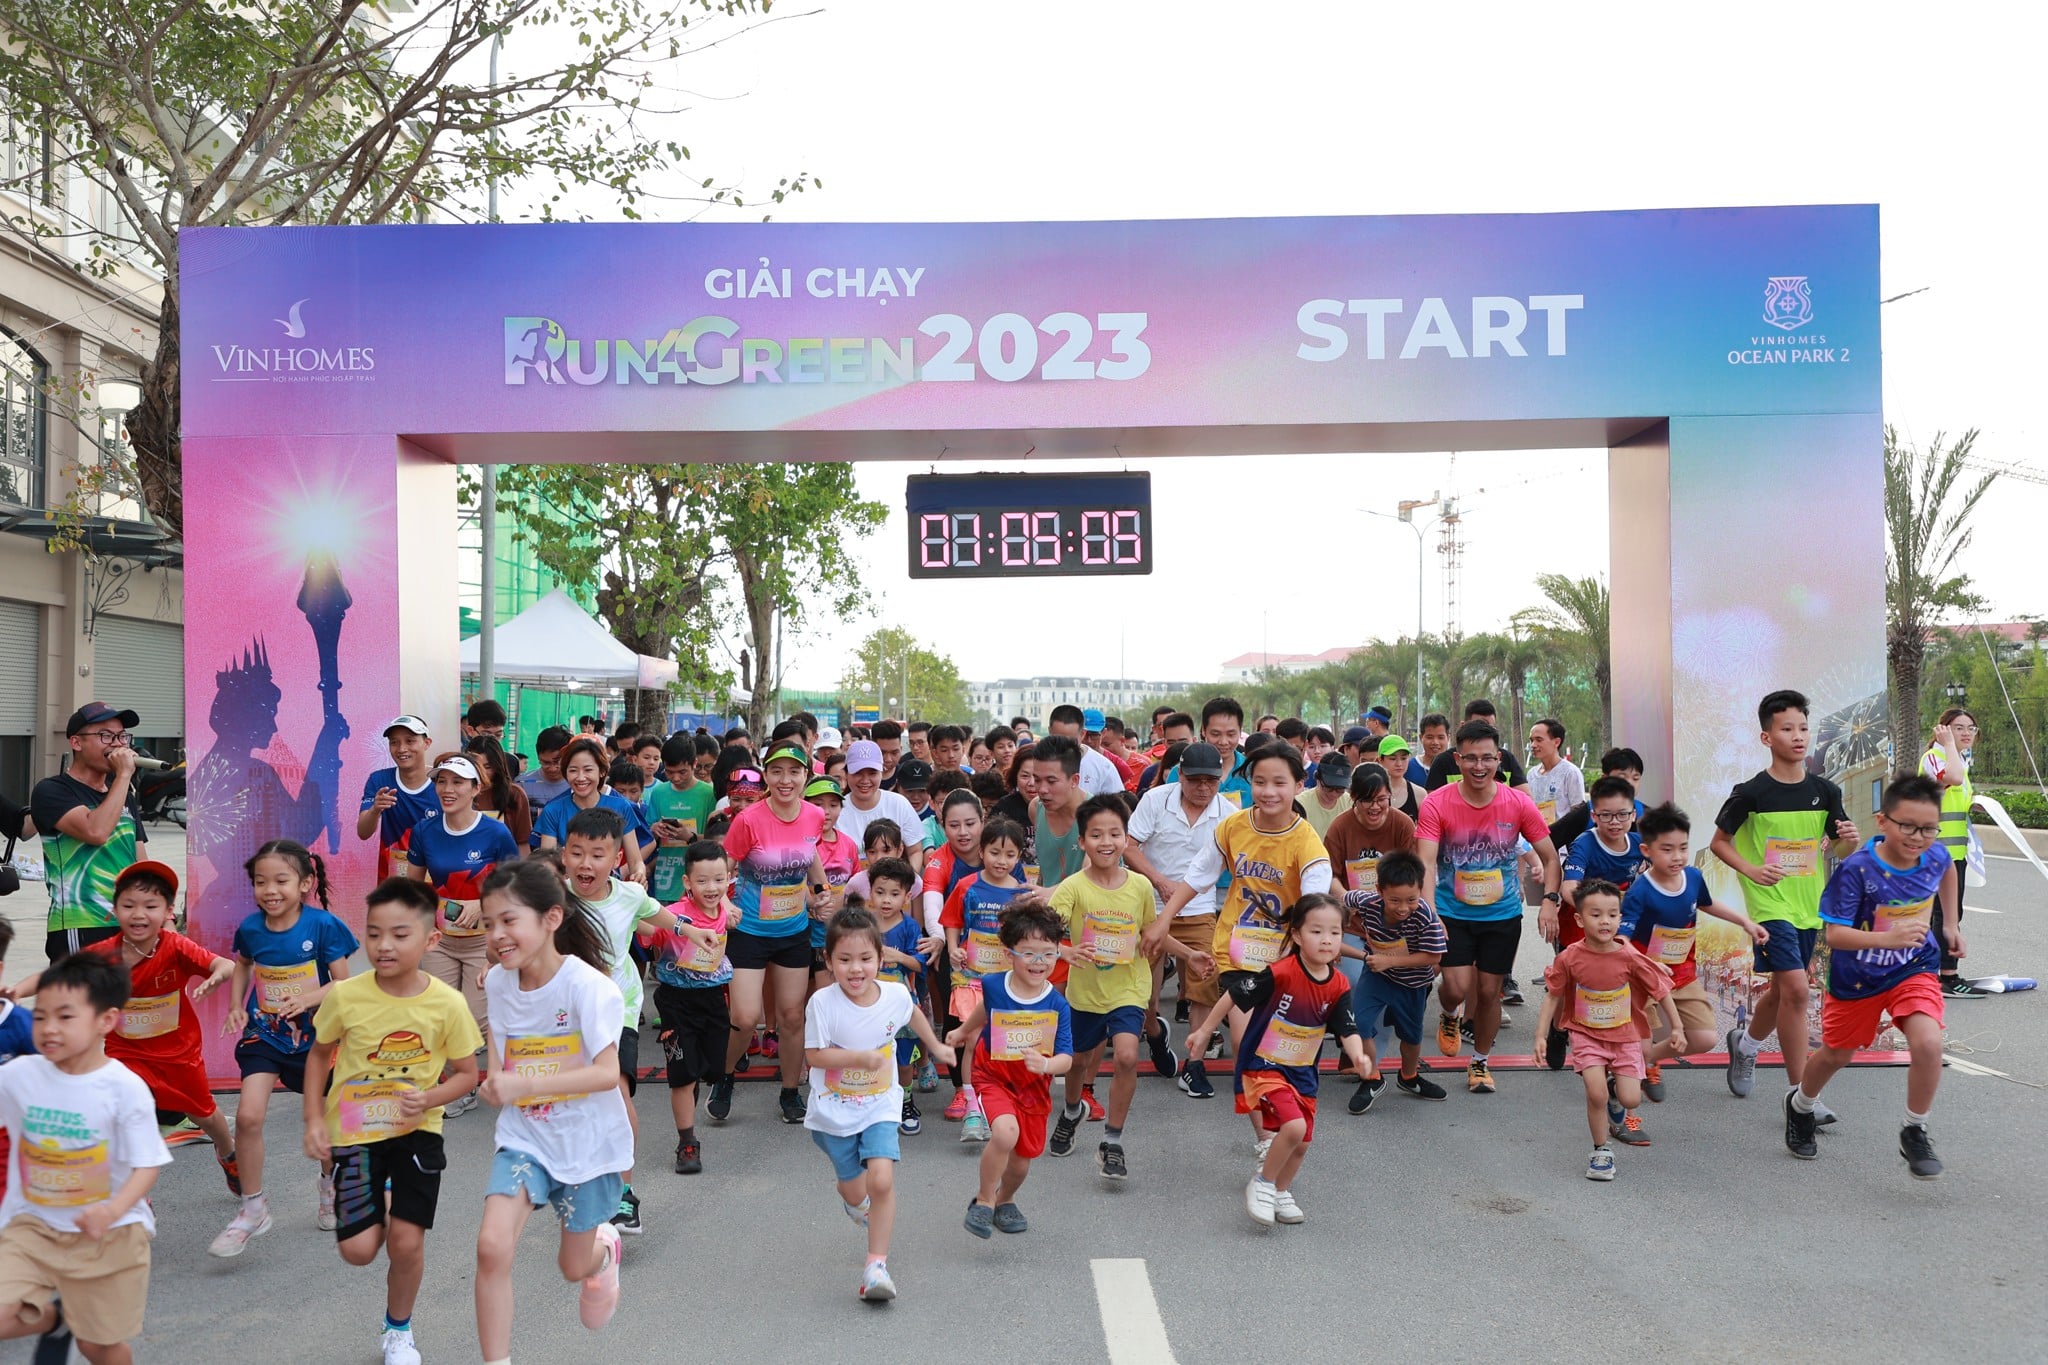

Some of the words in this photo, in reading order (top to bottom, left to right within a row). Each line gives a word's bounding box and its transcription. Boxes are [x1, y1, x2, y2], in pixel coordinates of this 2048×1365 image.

[704, 257, 792, 299] GIẢI
[806, 267, 926, 306] CHẠY
[1296, 294, 1584, 362] START
[1751, 335, 1826, 345] VINHOMES
[210, 344, 375, 373] VINHOMES
[1727, 349, 1787, 365] OCEAN
[1791, 348, 1836, 363] PARK
[1840, 347, 1850, 362] 2
[1234, 852, 1284, 887] LAKERS
[1095, 935, 1127, 951] 3008
[1244, 944, 1276, 959] 3008
[265, 985, 302, 997] 3096
[1007, 1030, 1043, 1044] 3002
